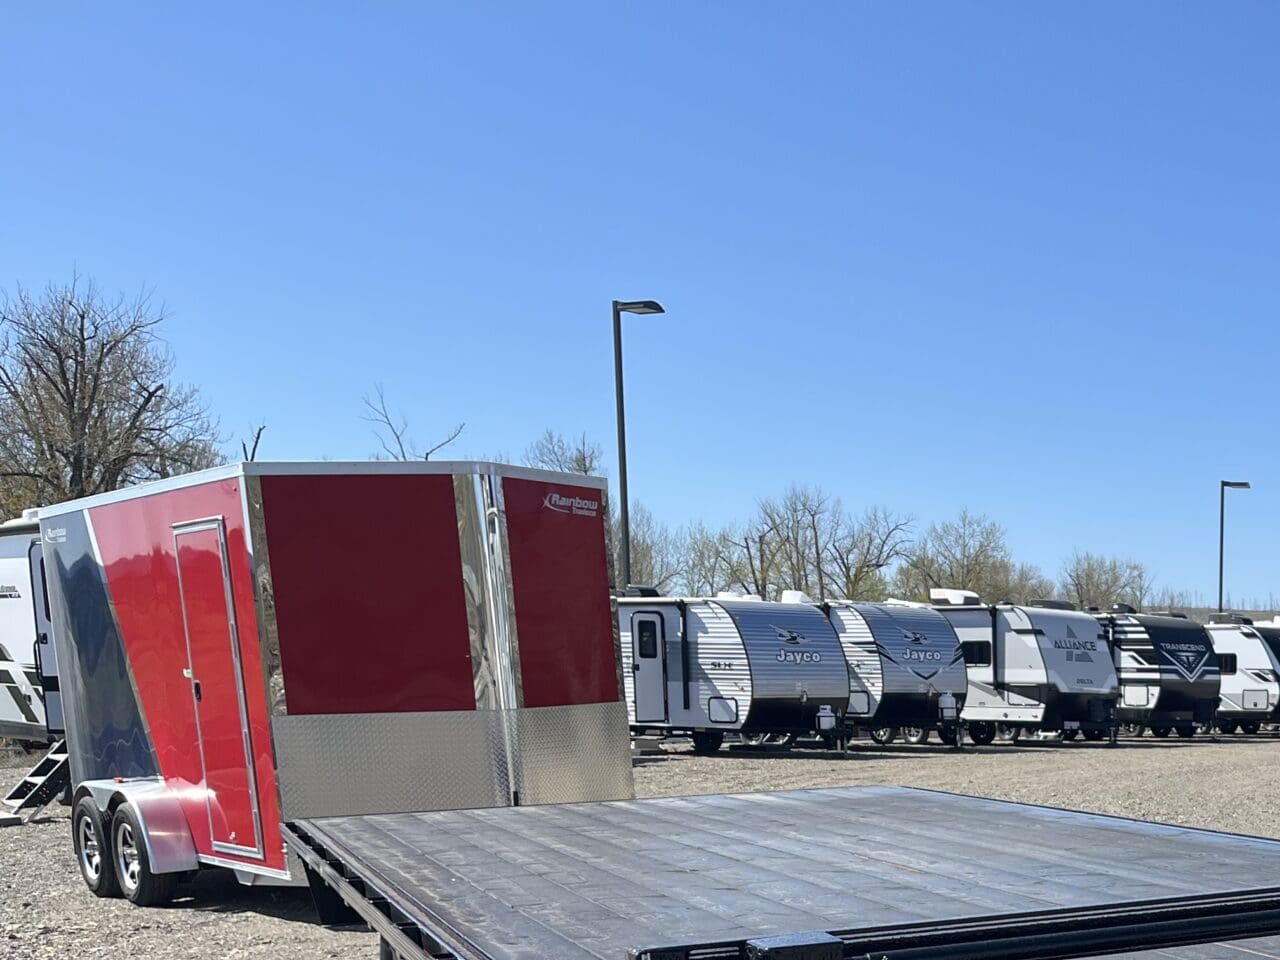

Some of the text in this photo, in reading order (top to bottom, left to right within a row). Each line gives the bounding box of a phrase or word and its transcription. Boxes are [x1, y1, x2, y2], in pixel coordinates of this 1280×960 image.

[1054, 639, 1097, 651] ALLIANCE
[777, 649, 821, 665] Jayco
[903, 648, 941, 663] Jayco
